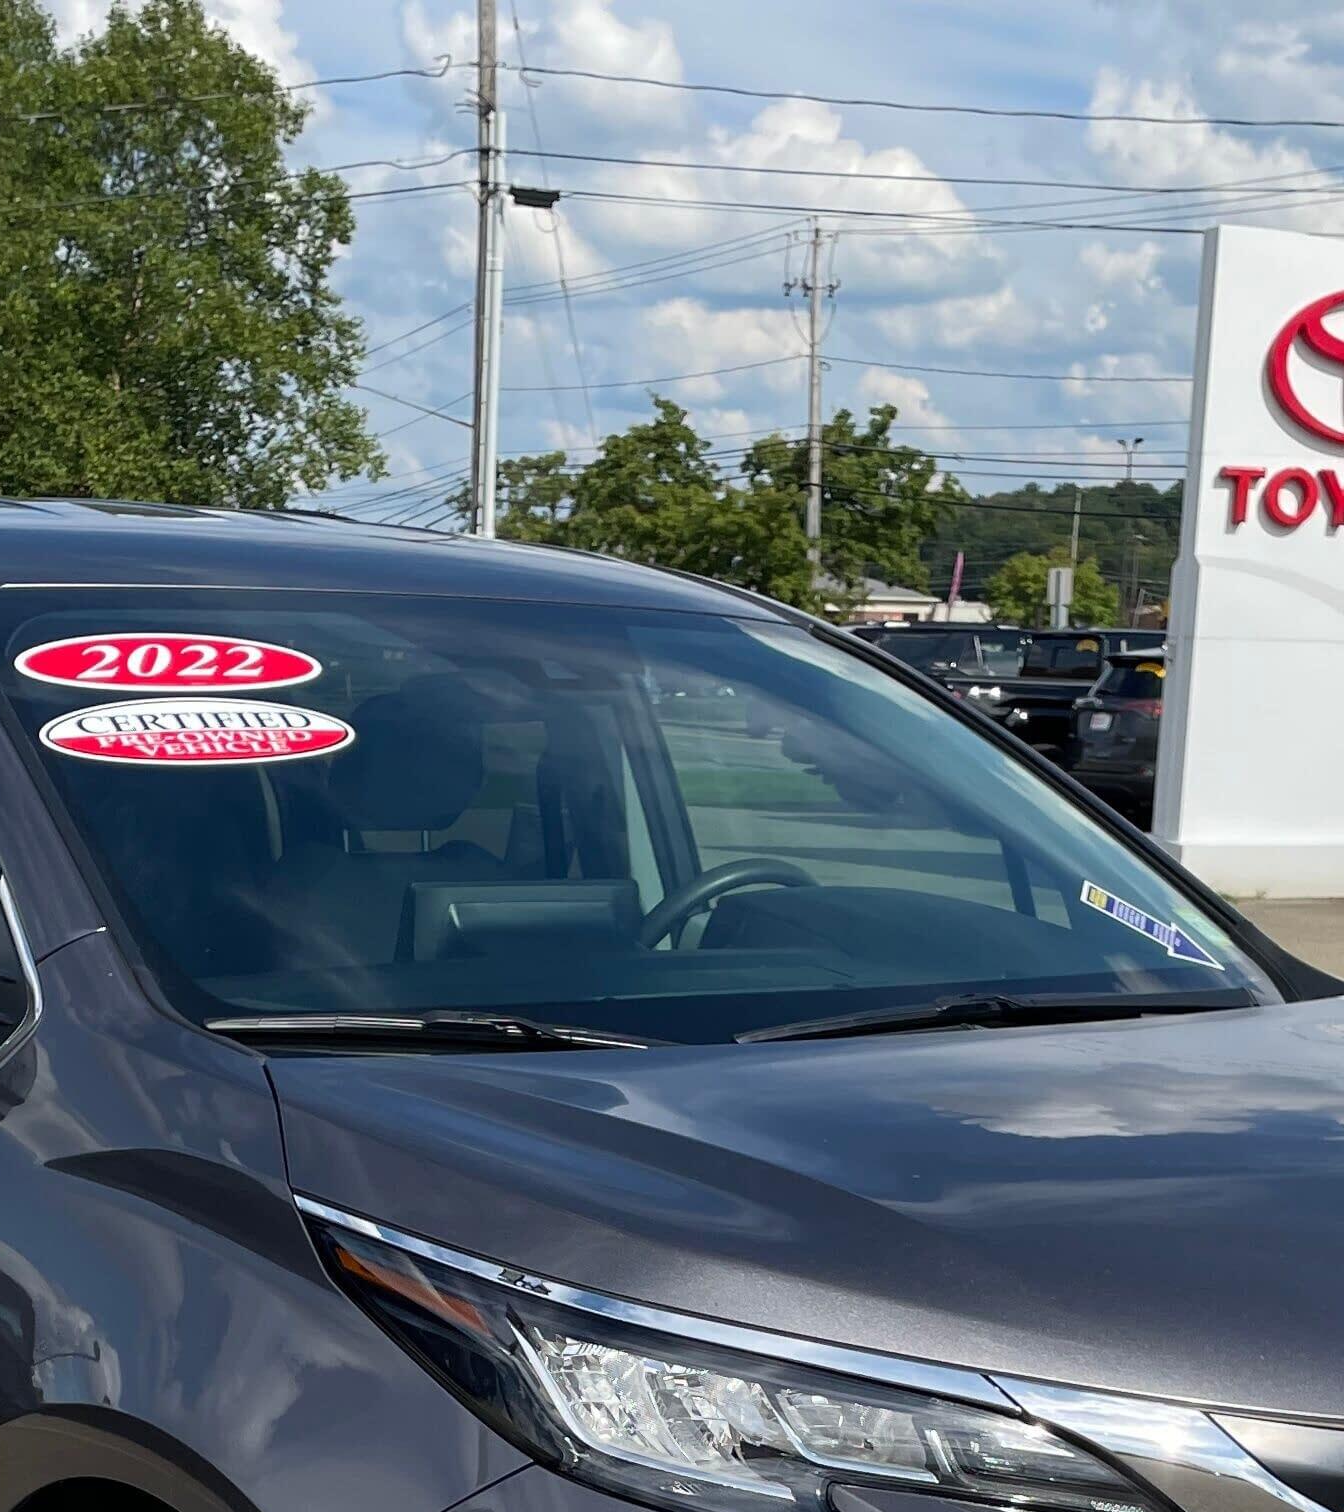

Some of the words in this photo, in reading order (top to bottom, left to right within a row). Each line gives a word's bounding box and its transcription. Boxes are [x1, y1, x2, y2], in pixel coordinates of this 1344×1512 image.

[76, 643, 264, 679] 2022
[76, 711, 312, 735] CERTIFIED
[96, 730, 313, 749] PRE-OWNED
[134, 741, 291, 757] VEHICLE
